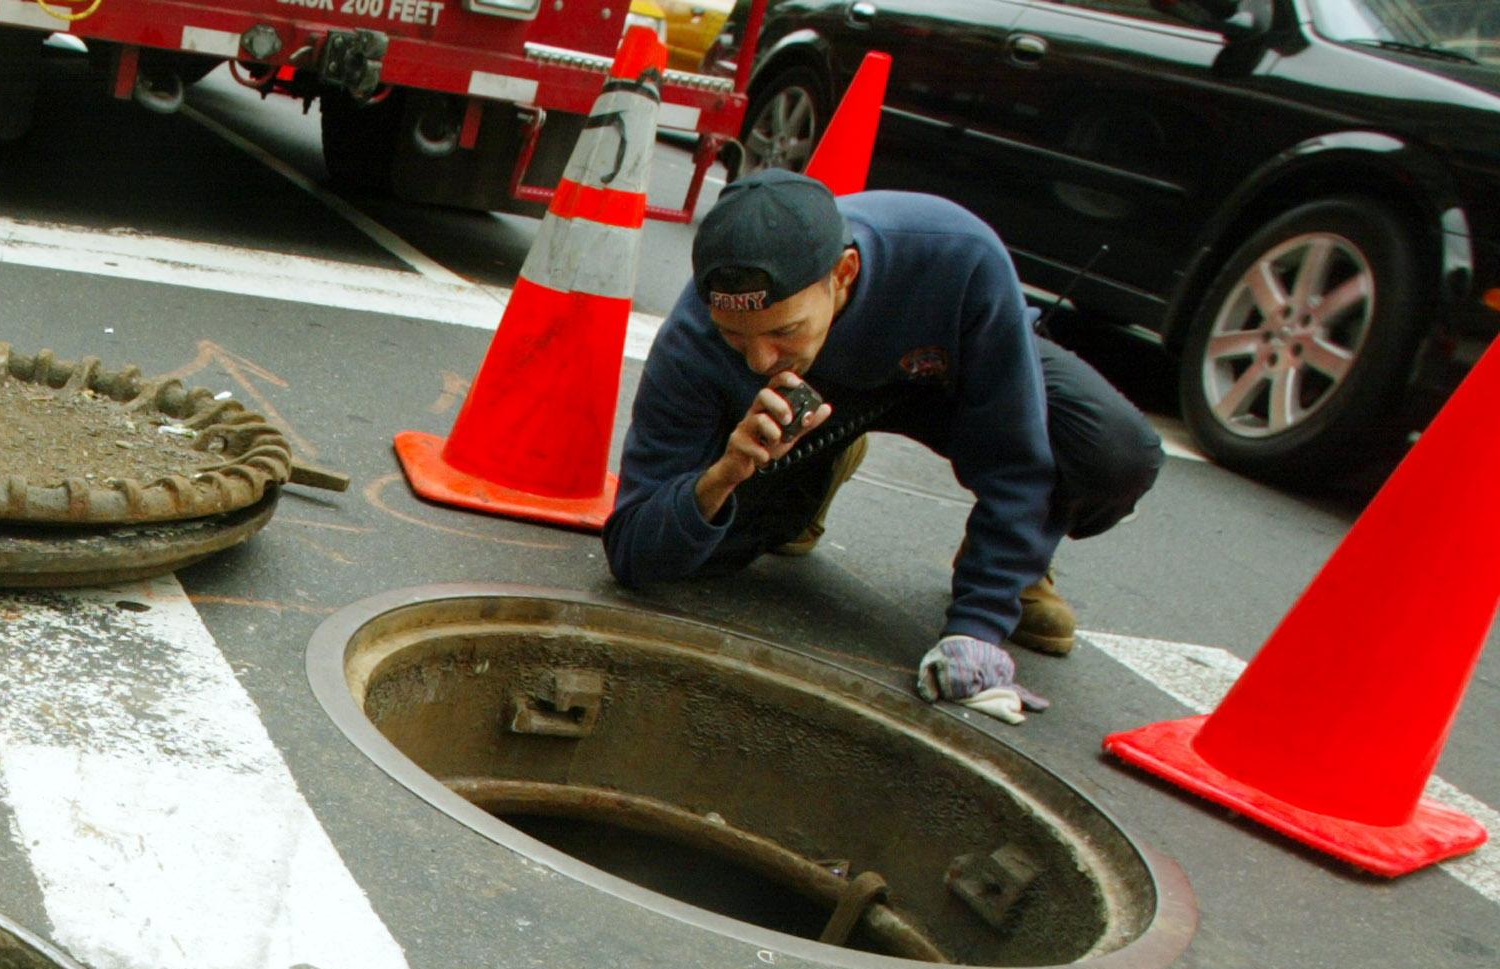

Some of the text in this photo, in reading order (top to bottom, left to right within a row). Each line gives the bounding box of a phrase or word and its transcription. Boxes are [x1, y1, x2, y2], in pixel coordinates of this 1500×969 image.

[340, 0, 385, 17] 200
[387, 0, 445, 26] FEET
[710, 290, 767, 310] FDNY
